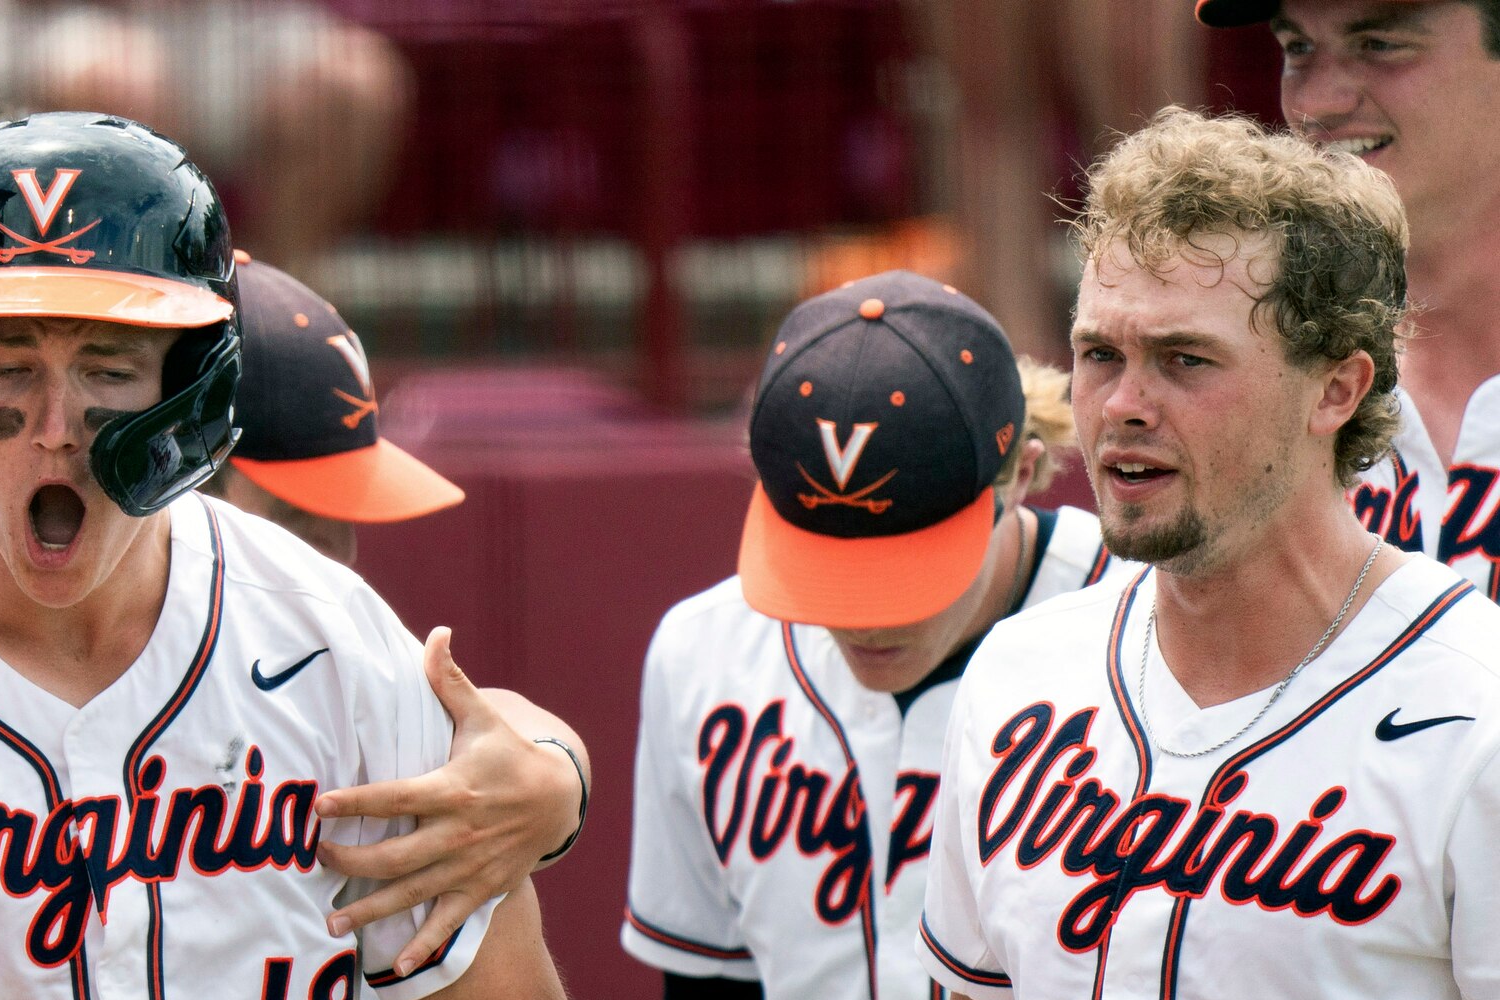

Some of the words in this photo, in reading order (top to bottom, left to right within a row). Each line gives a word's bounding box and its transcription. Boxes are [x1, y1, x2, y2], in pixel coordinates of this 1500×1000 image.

[11, 168, 83, 238] V
[815, 418, 879, 491] V
[977, 701, 1402, 954] Virginia
